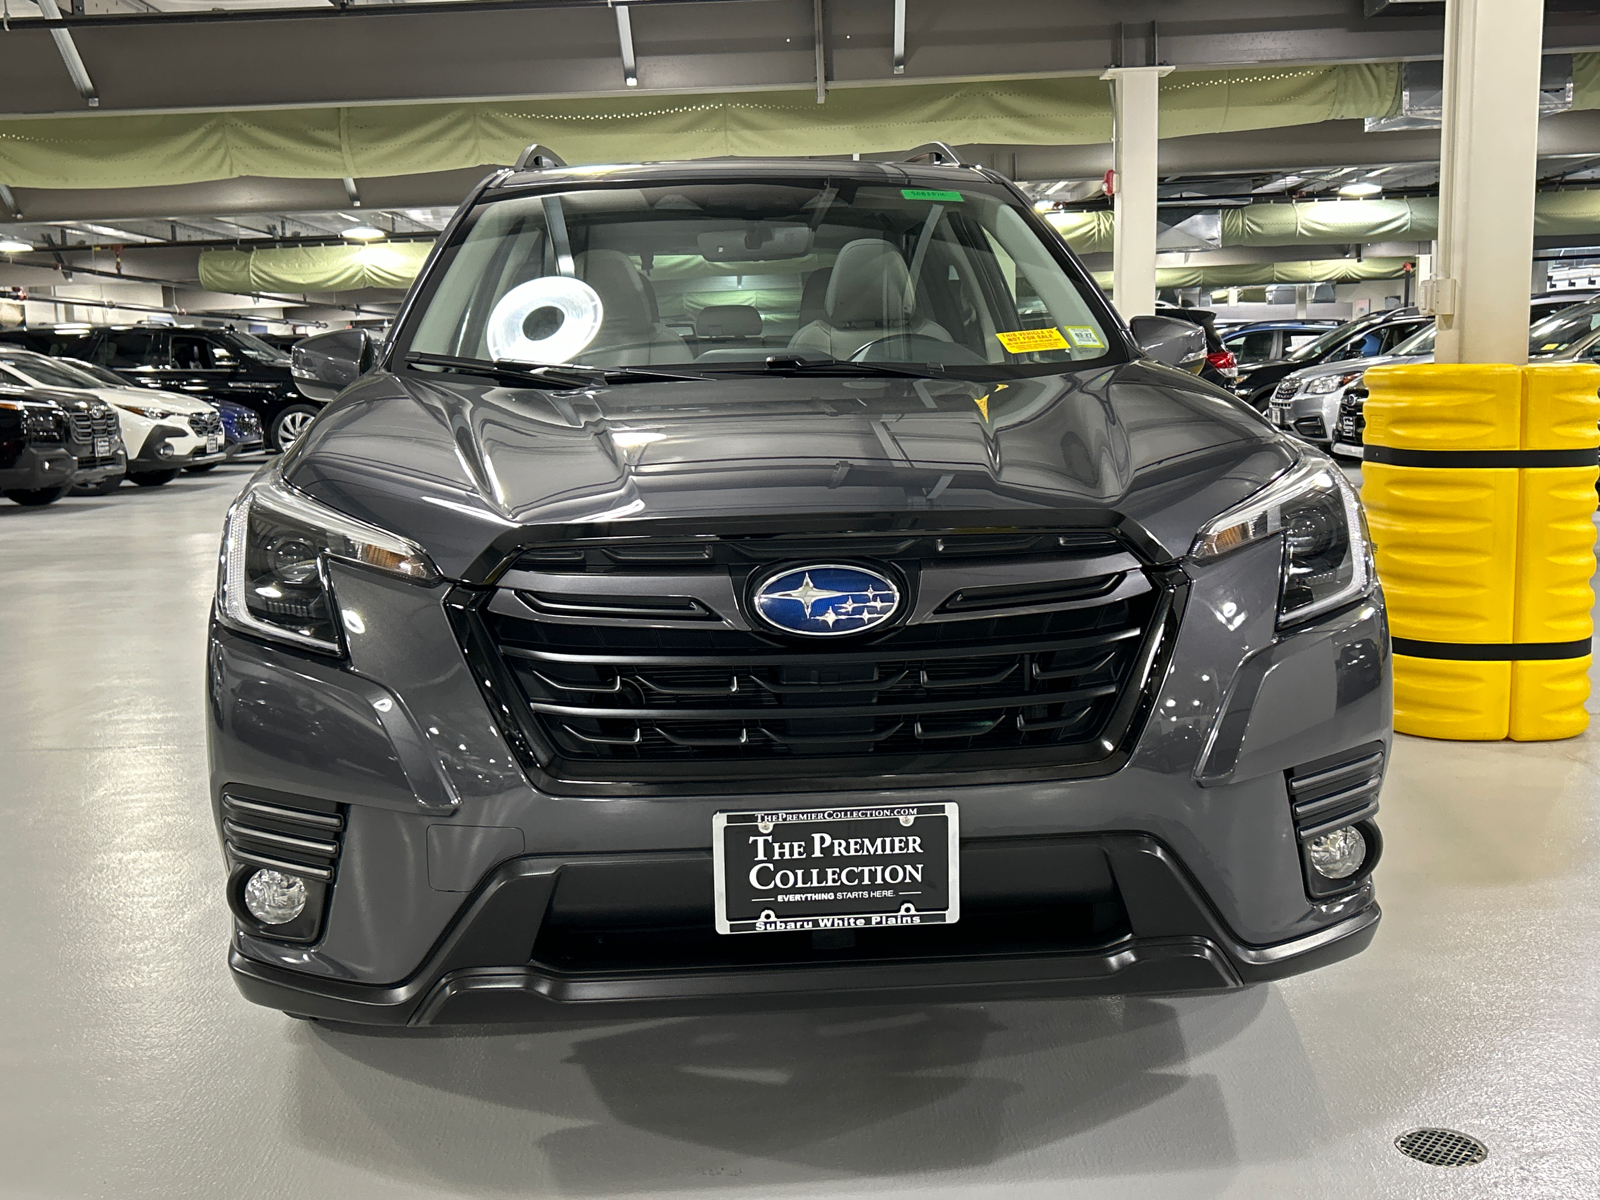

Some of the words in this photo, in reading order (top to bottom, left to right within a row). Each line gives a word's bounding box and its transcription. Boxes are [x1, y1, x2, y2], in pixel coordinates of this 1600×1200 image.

[748, 835, 807, 861] THE
[811, 833, 924, 858] PREMIER
[748, 863, 924, 890] COLLECTION
[777, 892, 835, 902] EVERYTHING
[836, 891, 869, 900] STARTS
[870, 889, 896, 898] HERE.
[755, 920, 813, 931] Subaru
[818, 917, 866, 928] White
[871, 915, 921, 926] Plains
